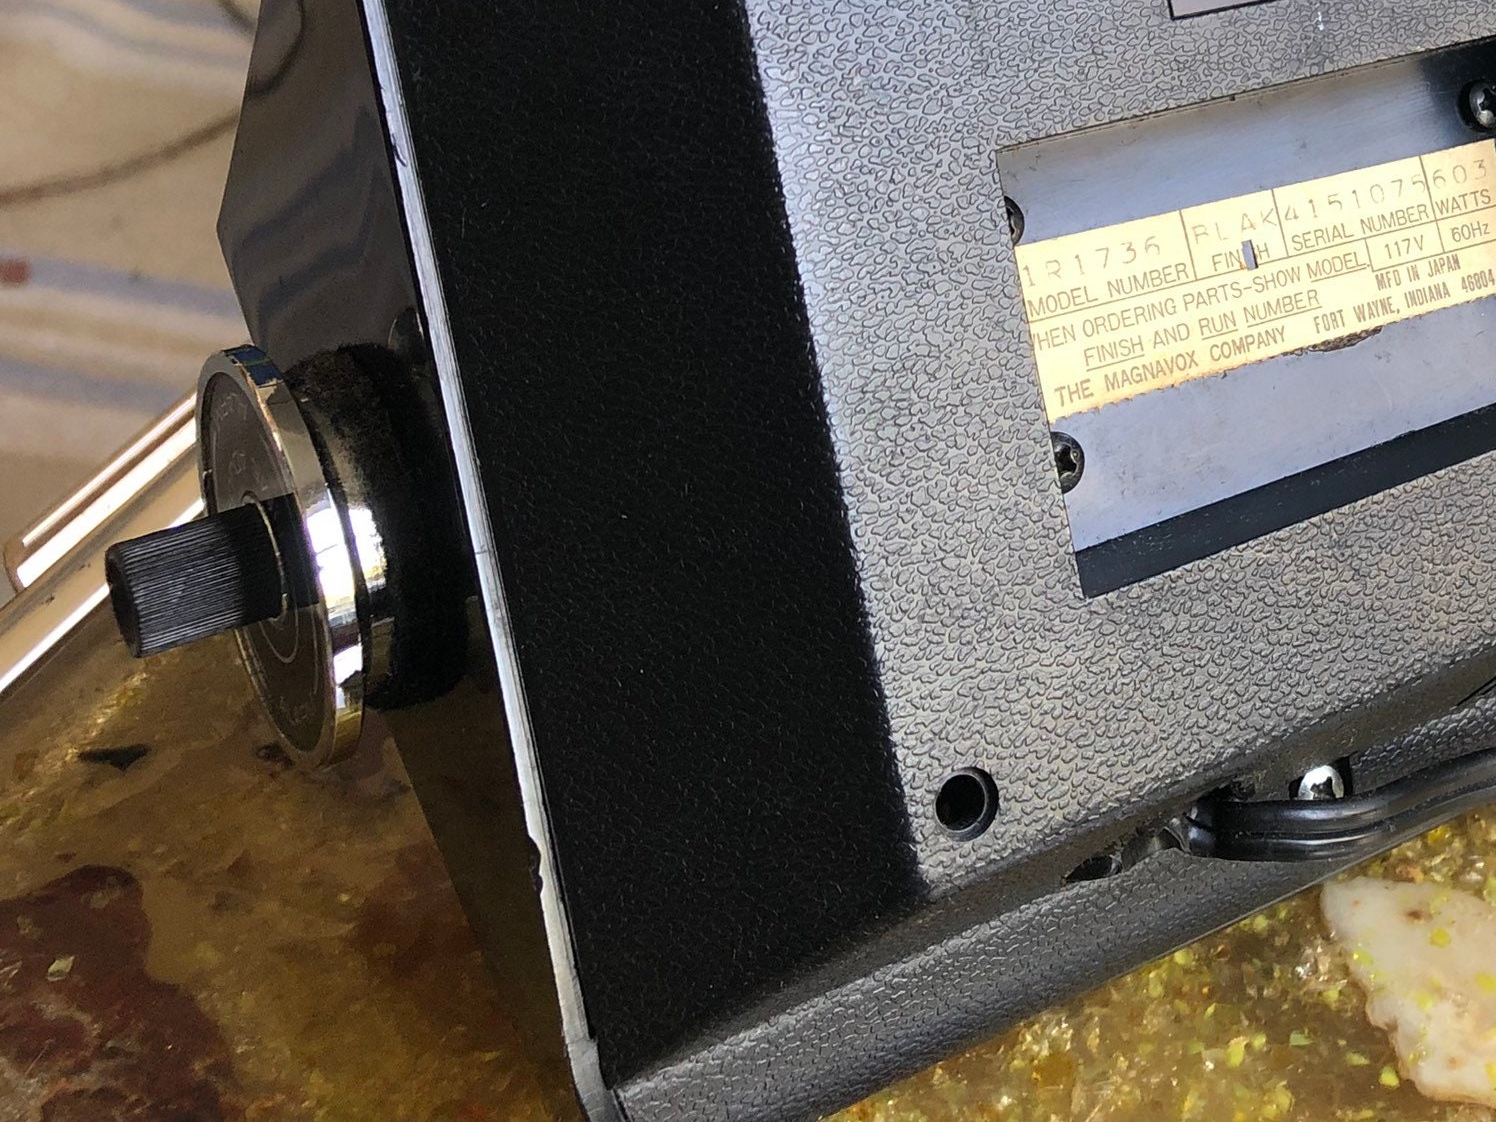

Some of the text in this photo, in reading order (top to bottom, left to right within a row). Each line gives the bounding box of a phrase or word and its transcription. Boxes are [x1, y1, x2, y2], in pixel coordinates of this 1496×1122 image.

[1432, 155, 1493, 189] 603
[1431, 185, 1495, 219] WATTS
[1291, 203, 1430, 252] SERIAL NUMBER
[1383, 233, 1424, 260] 117V
[1449, 214, 1495, 243] 60Hz
[1022, 235, 1160, 288] 1R1736
[1211, 241, 1271, 273] FINH
[1374, 252, 1462, 292] MFD IN JAPAN
[1024, 261, 1190, 321] MODEL NUMBER
[1082, 297, 1178, 338] ORDERING
[1182, 265, 1301, 312] PARTS-SHOW
[1312, 268, 1496, 335] FORT WAYNE, INDIANA 46804
[1083, 288, 1320, 367] FINISH AND RUN NUMBER
[1053, 324, 1285, 407] THE MAGNAVOX COMPANY
